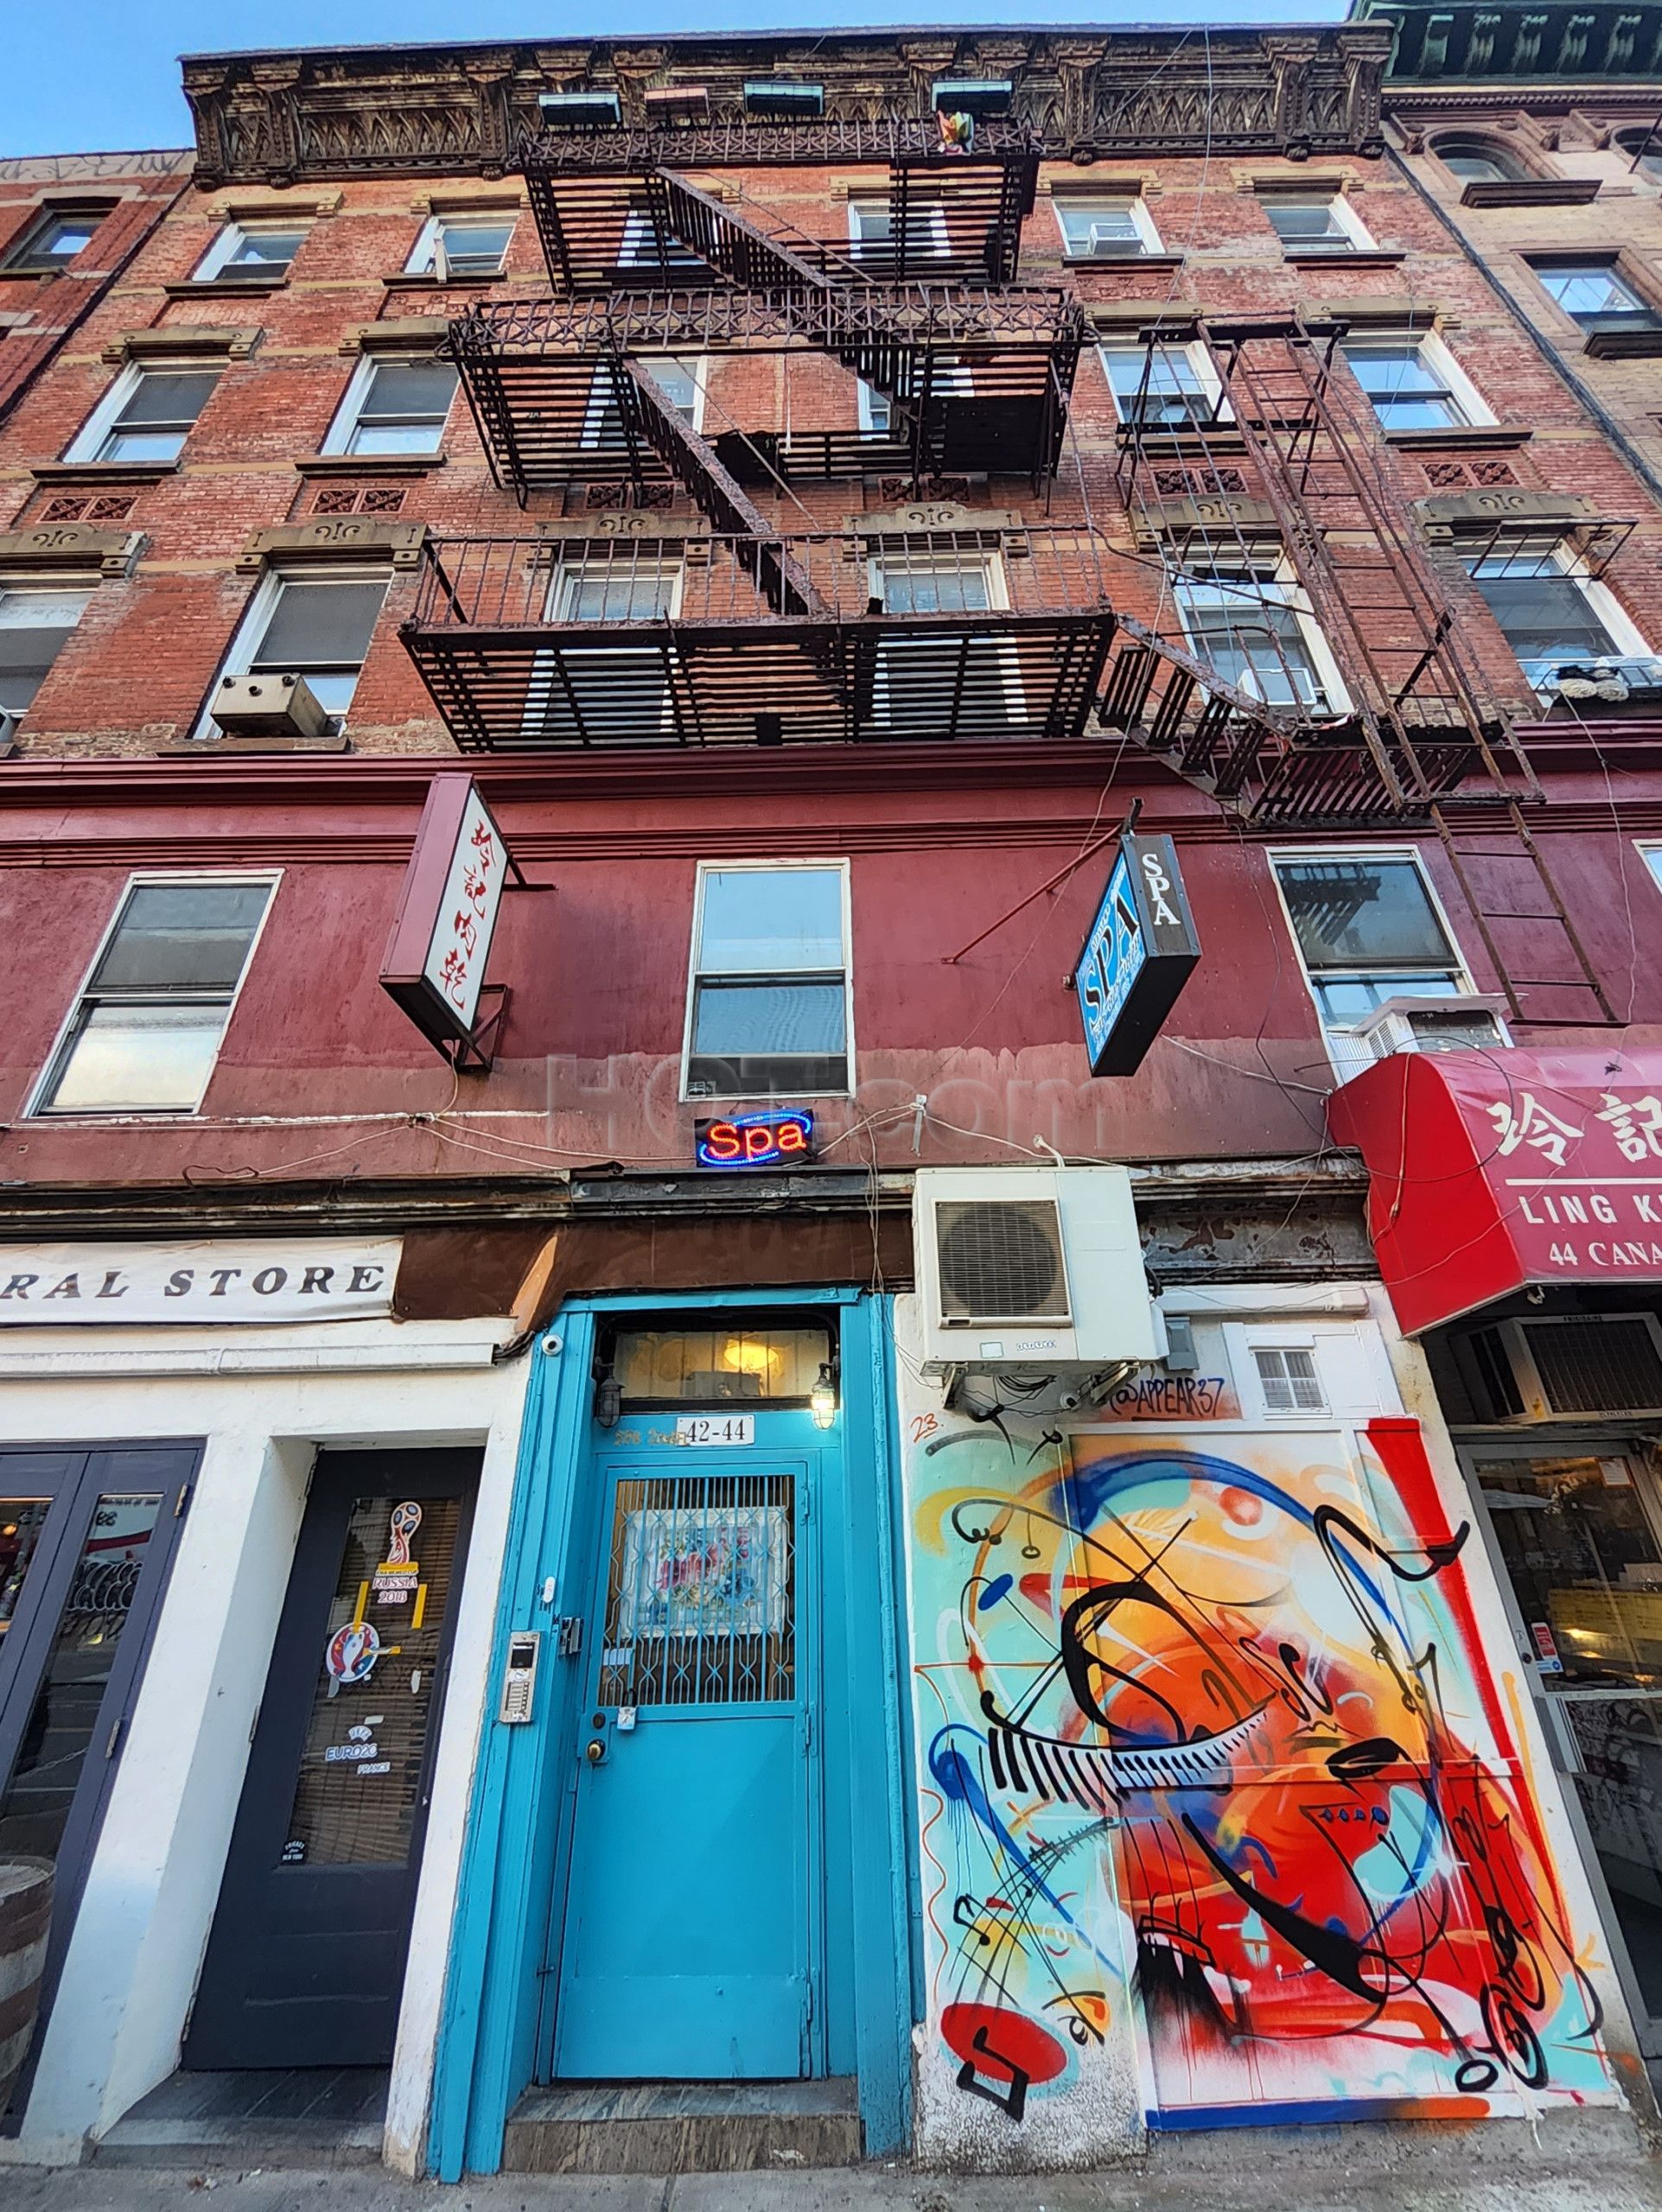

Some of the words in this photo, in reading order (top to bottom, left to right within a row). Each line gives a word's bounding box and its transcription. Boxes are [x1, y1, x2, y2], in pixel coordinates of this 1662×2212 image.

[1142, 853, 1181, 925] SPA
[1085, 890, 1139, 1030] SPA
[708, 1122, 806, 1160] Spa
[1519, 1195, 1618, 1224] LING
[1633, 1195, 1662, 1224] K
[1549, 1243, 1579, 1266] 44
[0, 1271, 130, 1299] RAL
[164, 1266, 385, 1297] STORE
[686, 1419, 745, 1442] 42-44
[373, 1577, 417, 1589] RUSSIA
[378, 1591, 407, 1603] 2018
[358, 1763, 391, 1774] FRANCE
